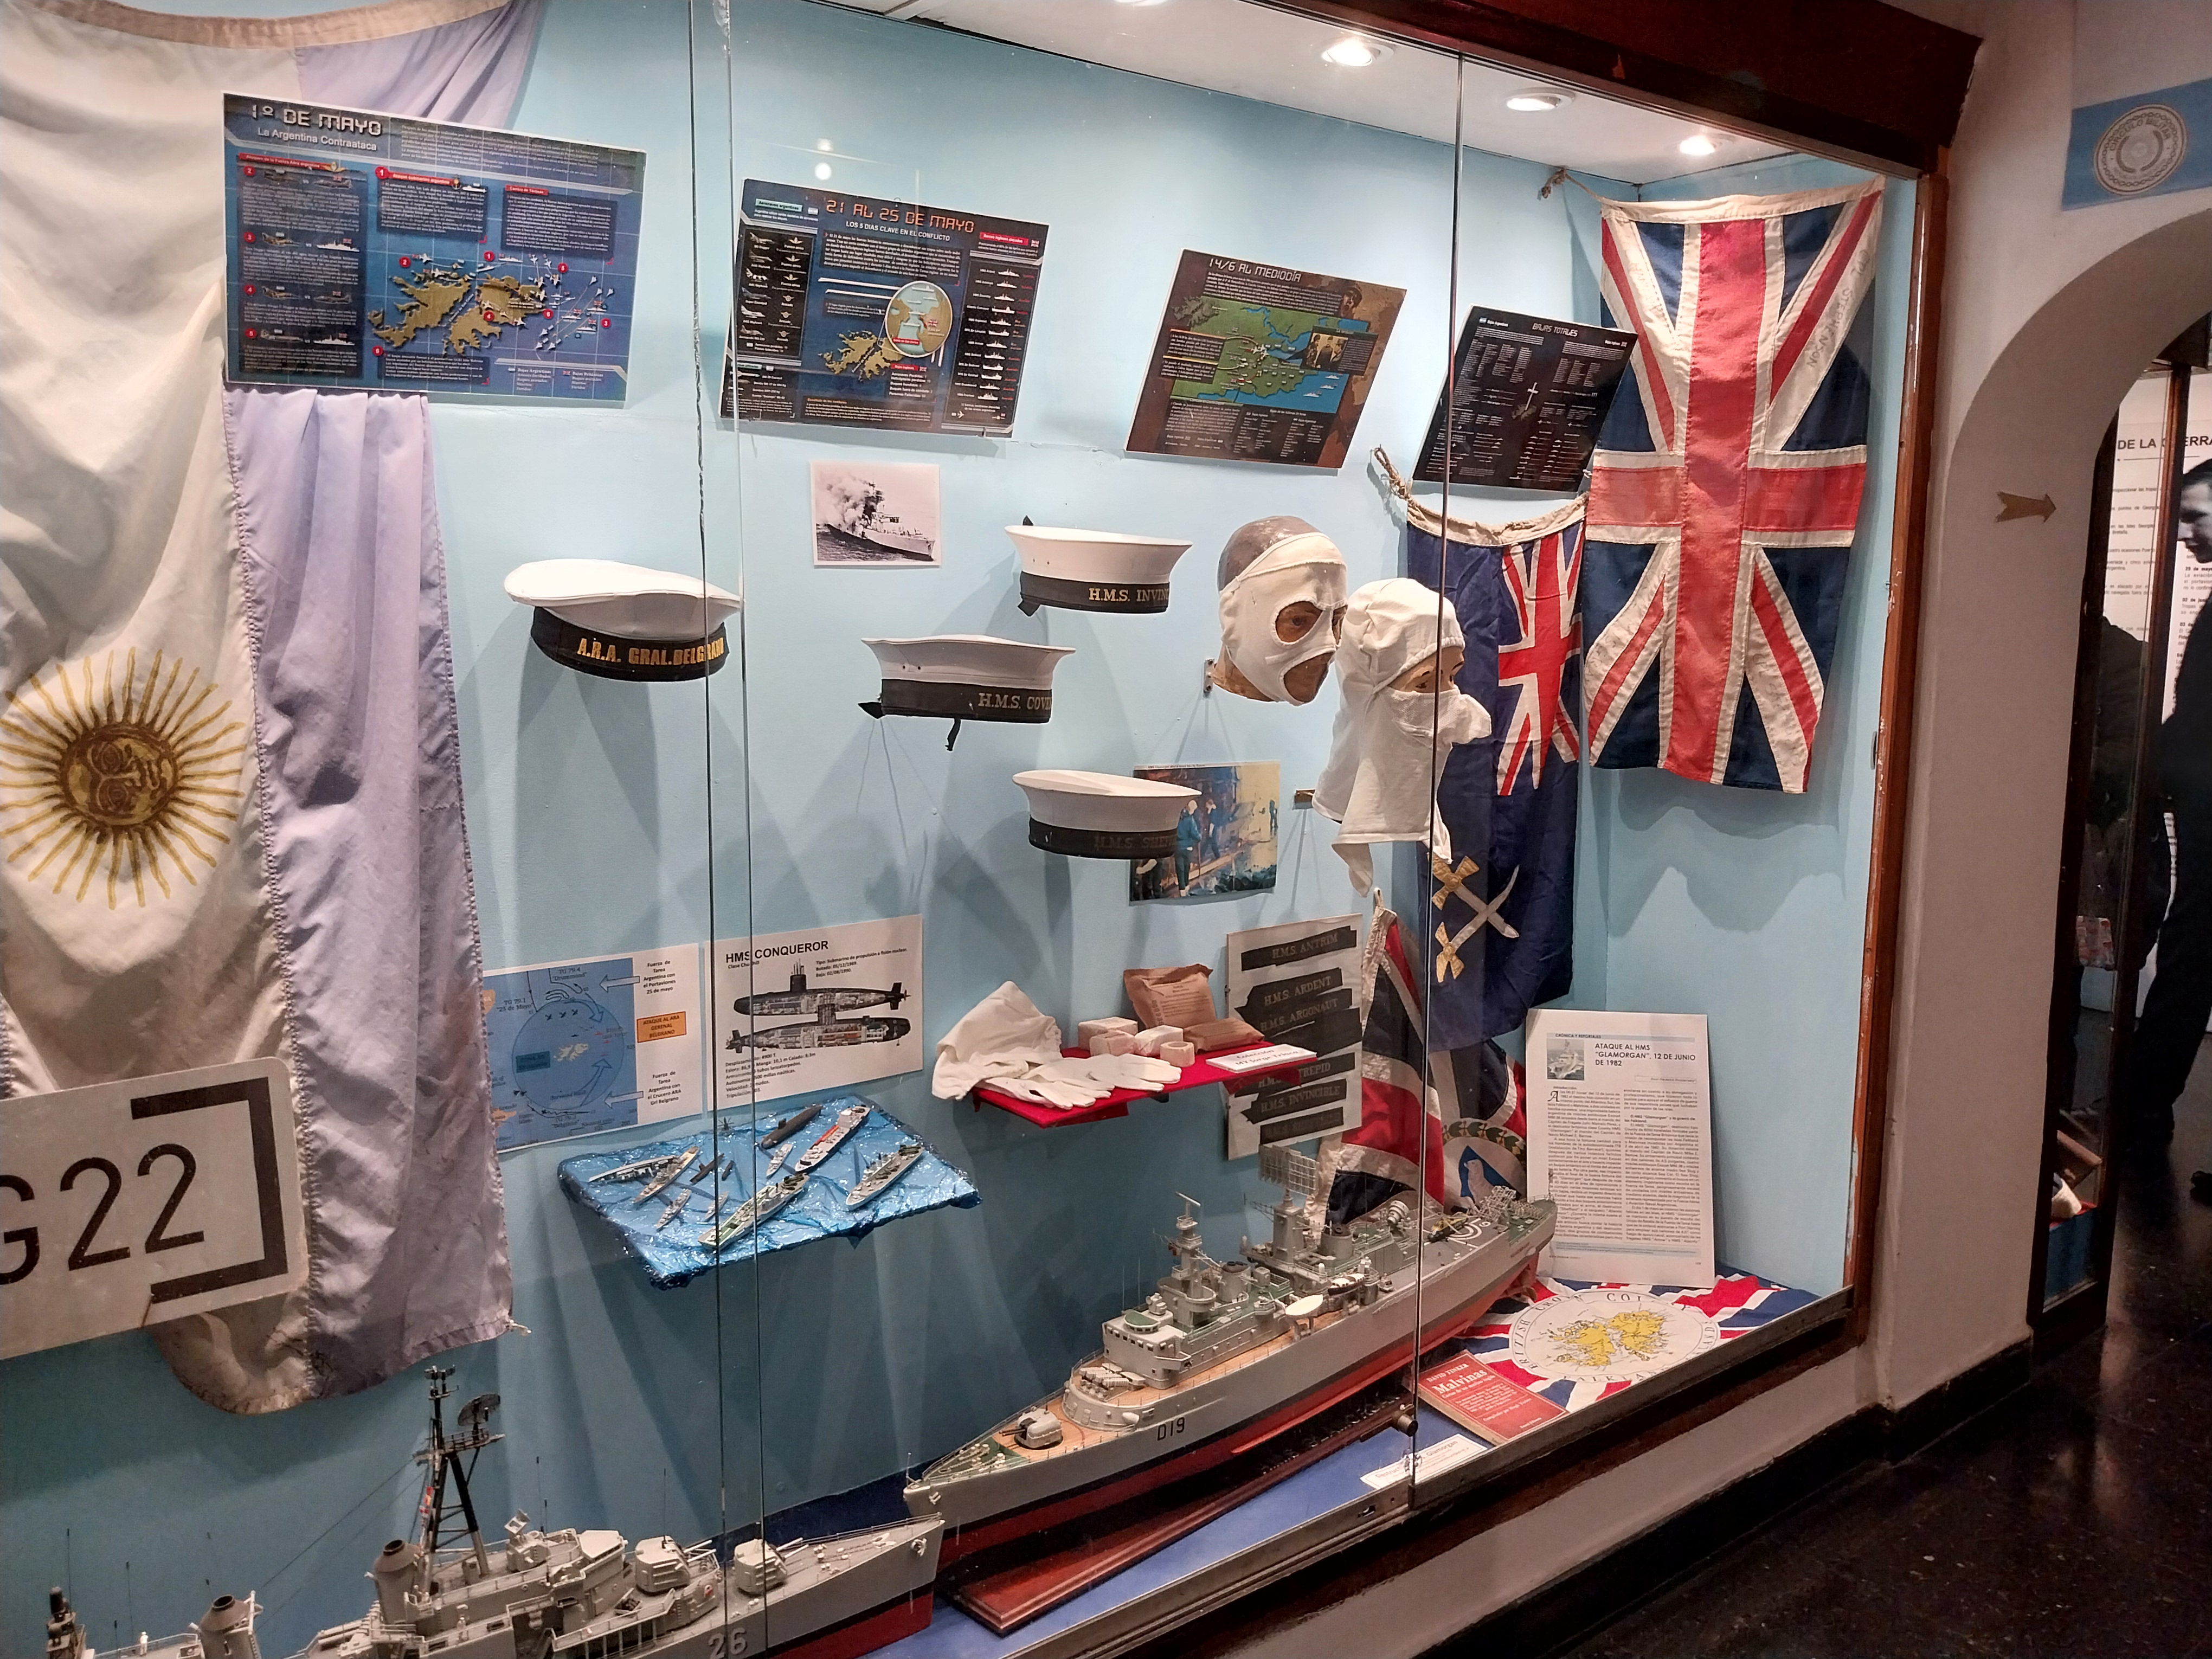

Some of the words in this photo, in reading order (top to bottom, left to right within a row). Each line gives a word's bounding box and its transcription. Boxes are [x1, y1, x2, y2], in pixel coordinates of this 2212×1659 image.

[283, 108, 311, 127] DE
[319, 113, 382, 137] MAYO
[258, 127, 270, 137] La
[272, 129, 318, 144] Argentina
[320, 136, 378, 151] Contraataca
[826, 200, 844, 213] 21
[853, 203, 873, 218] AL
[879, 208, 900, 222] 25
[905, 211, 925, 226] DE
[930, 215, 975, 234] MAYO
[879, 225, 899, 234] CLAVE
[918, 230, 950, 242] CONFLICTO
[1209, 258, 1236, 272] 14/6
[1238, 263, 1252, 275] AL
[1532, 322, 1553, 333] BAJAS
[1553, 325, 1579, 337] TOTALES
[2118, 439, 2136, 450] DE
[2139, 438, 2157, 449] LA
[1089, 588, 1130, 602] H.M.S.
[577, 638, 621, 663] A.R.A.
[978, 692, 1021, 709] H.M.S.
[725, 951, 750, 963] HMS
[755, 940, 829, 960] CONQUEROR
[1272, 945, 1297, 959] H.M.S.
[1300, 932, 1339, 953] ANTRIM
[827, 956, 850, 964] Submarino
[648, 979, 676, 987] Portaviones
[1264, 989, 1290, 1007] H.M.S.
[1294, 975, 1332, 997] ARDENT
[1289, 998, 1339, 1024] ARGONAUT
[1288, 1085, 1341, 1105] INVINCIBLE
[1426, 1371, 1447, 1382] DAVID
[1445, 1363, 1469, 1375] TINKER
[1432, 1368, 1488, 1394] Malvinas
[1158, 1417, 1187, 1442] D19
